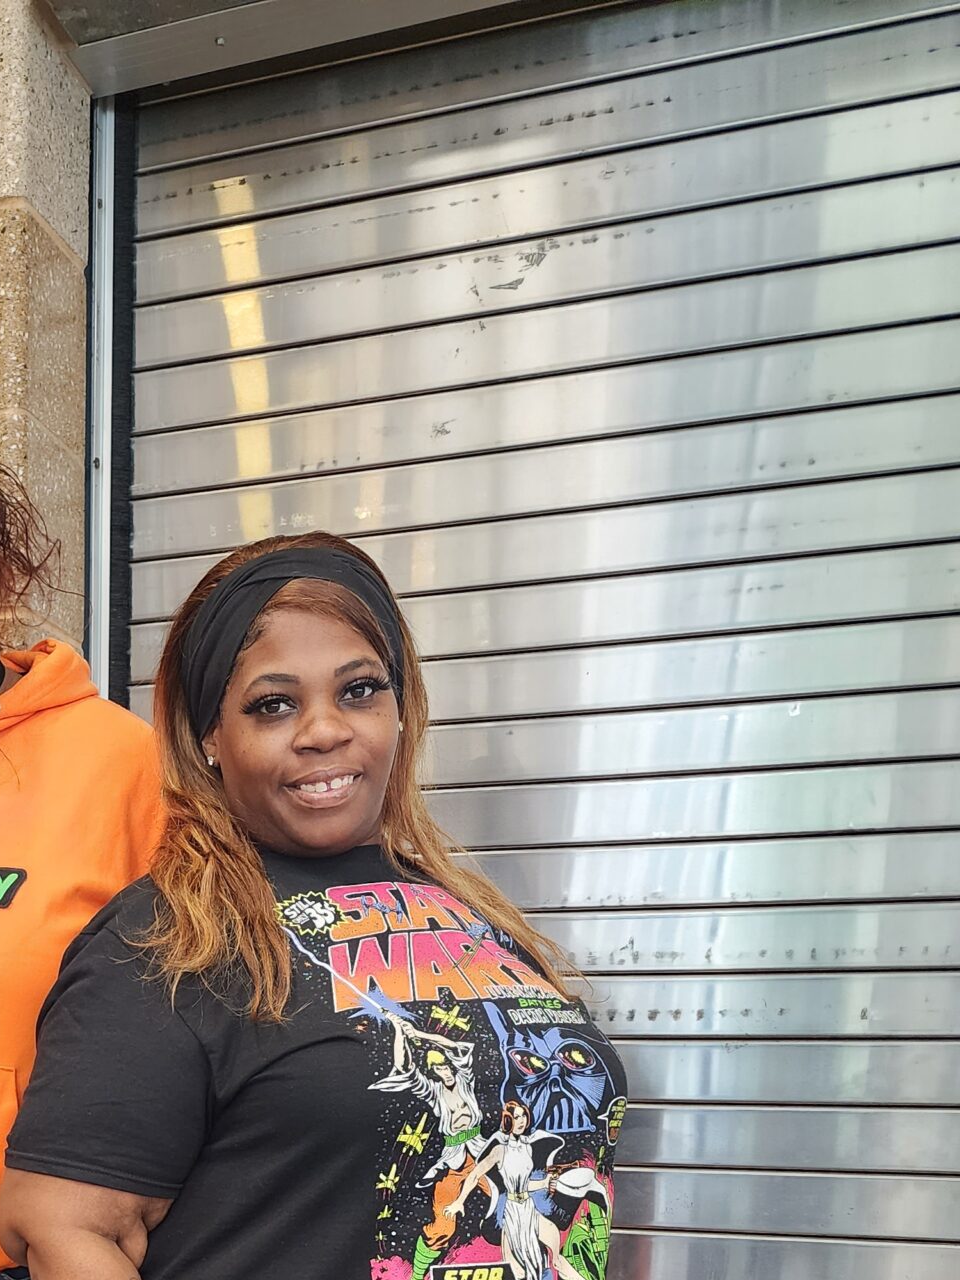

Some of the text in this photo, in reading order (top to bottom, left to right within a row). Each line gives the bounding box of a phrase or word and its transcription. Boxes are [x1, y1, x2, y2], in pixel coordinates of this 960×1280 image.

[284, 898, 315, 919] STILL
[326, 882, 492, 942] STAR
[328, 929, 569, 1013] WARS
[518, 998, 562, 1009] BATTLES
